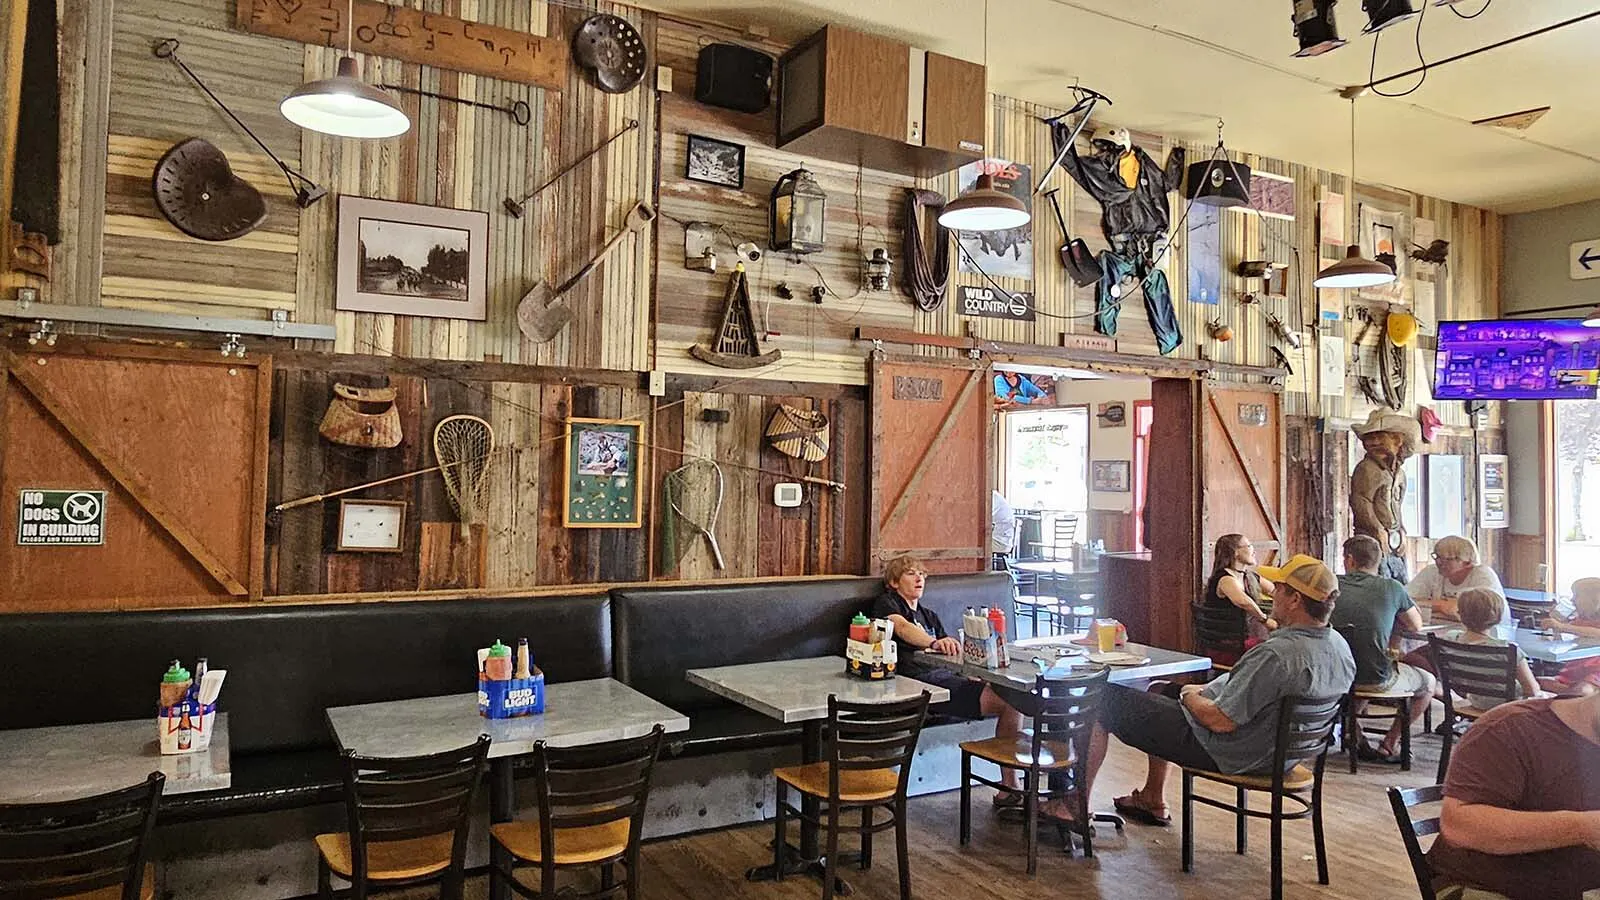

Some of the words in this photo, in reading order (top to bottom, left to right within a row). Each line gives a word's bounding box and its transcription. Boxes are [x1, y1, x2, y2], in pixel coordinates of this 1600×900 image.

[964, 287, 993, 301] WILD
[964, 299, 1010, 313] COUNTRY
[24, 492, 44, 505] NO
[23, 508, 60, 521] DOGS
[22, 523, 37, 536] IN
[39, 523, 99, 537] BUILDING
[508, 688, 533, 699] BUD
[504, 694, 536, 708] LIGHT
